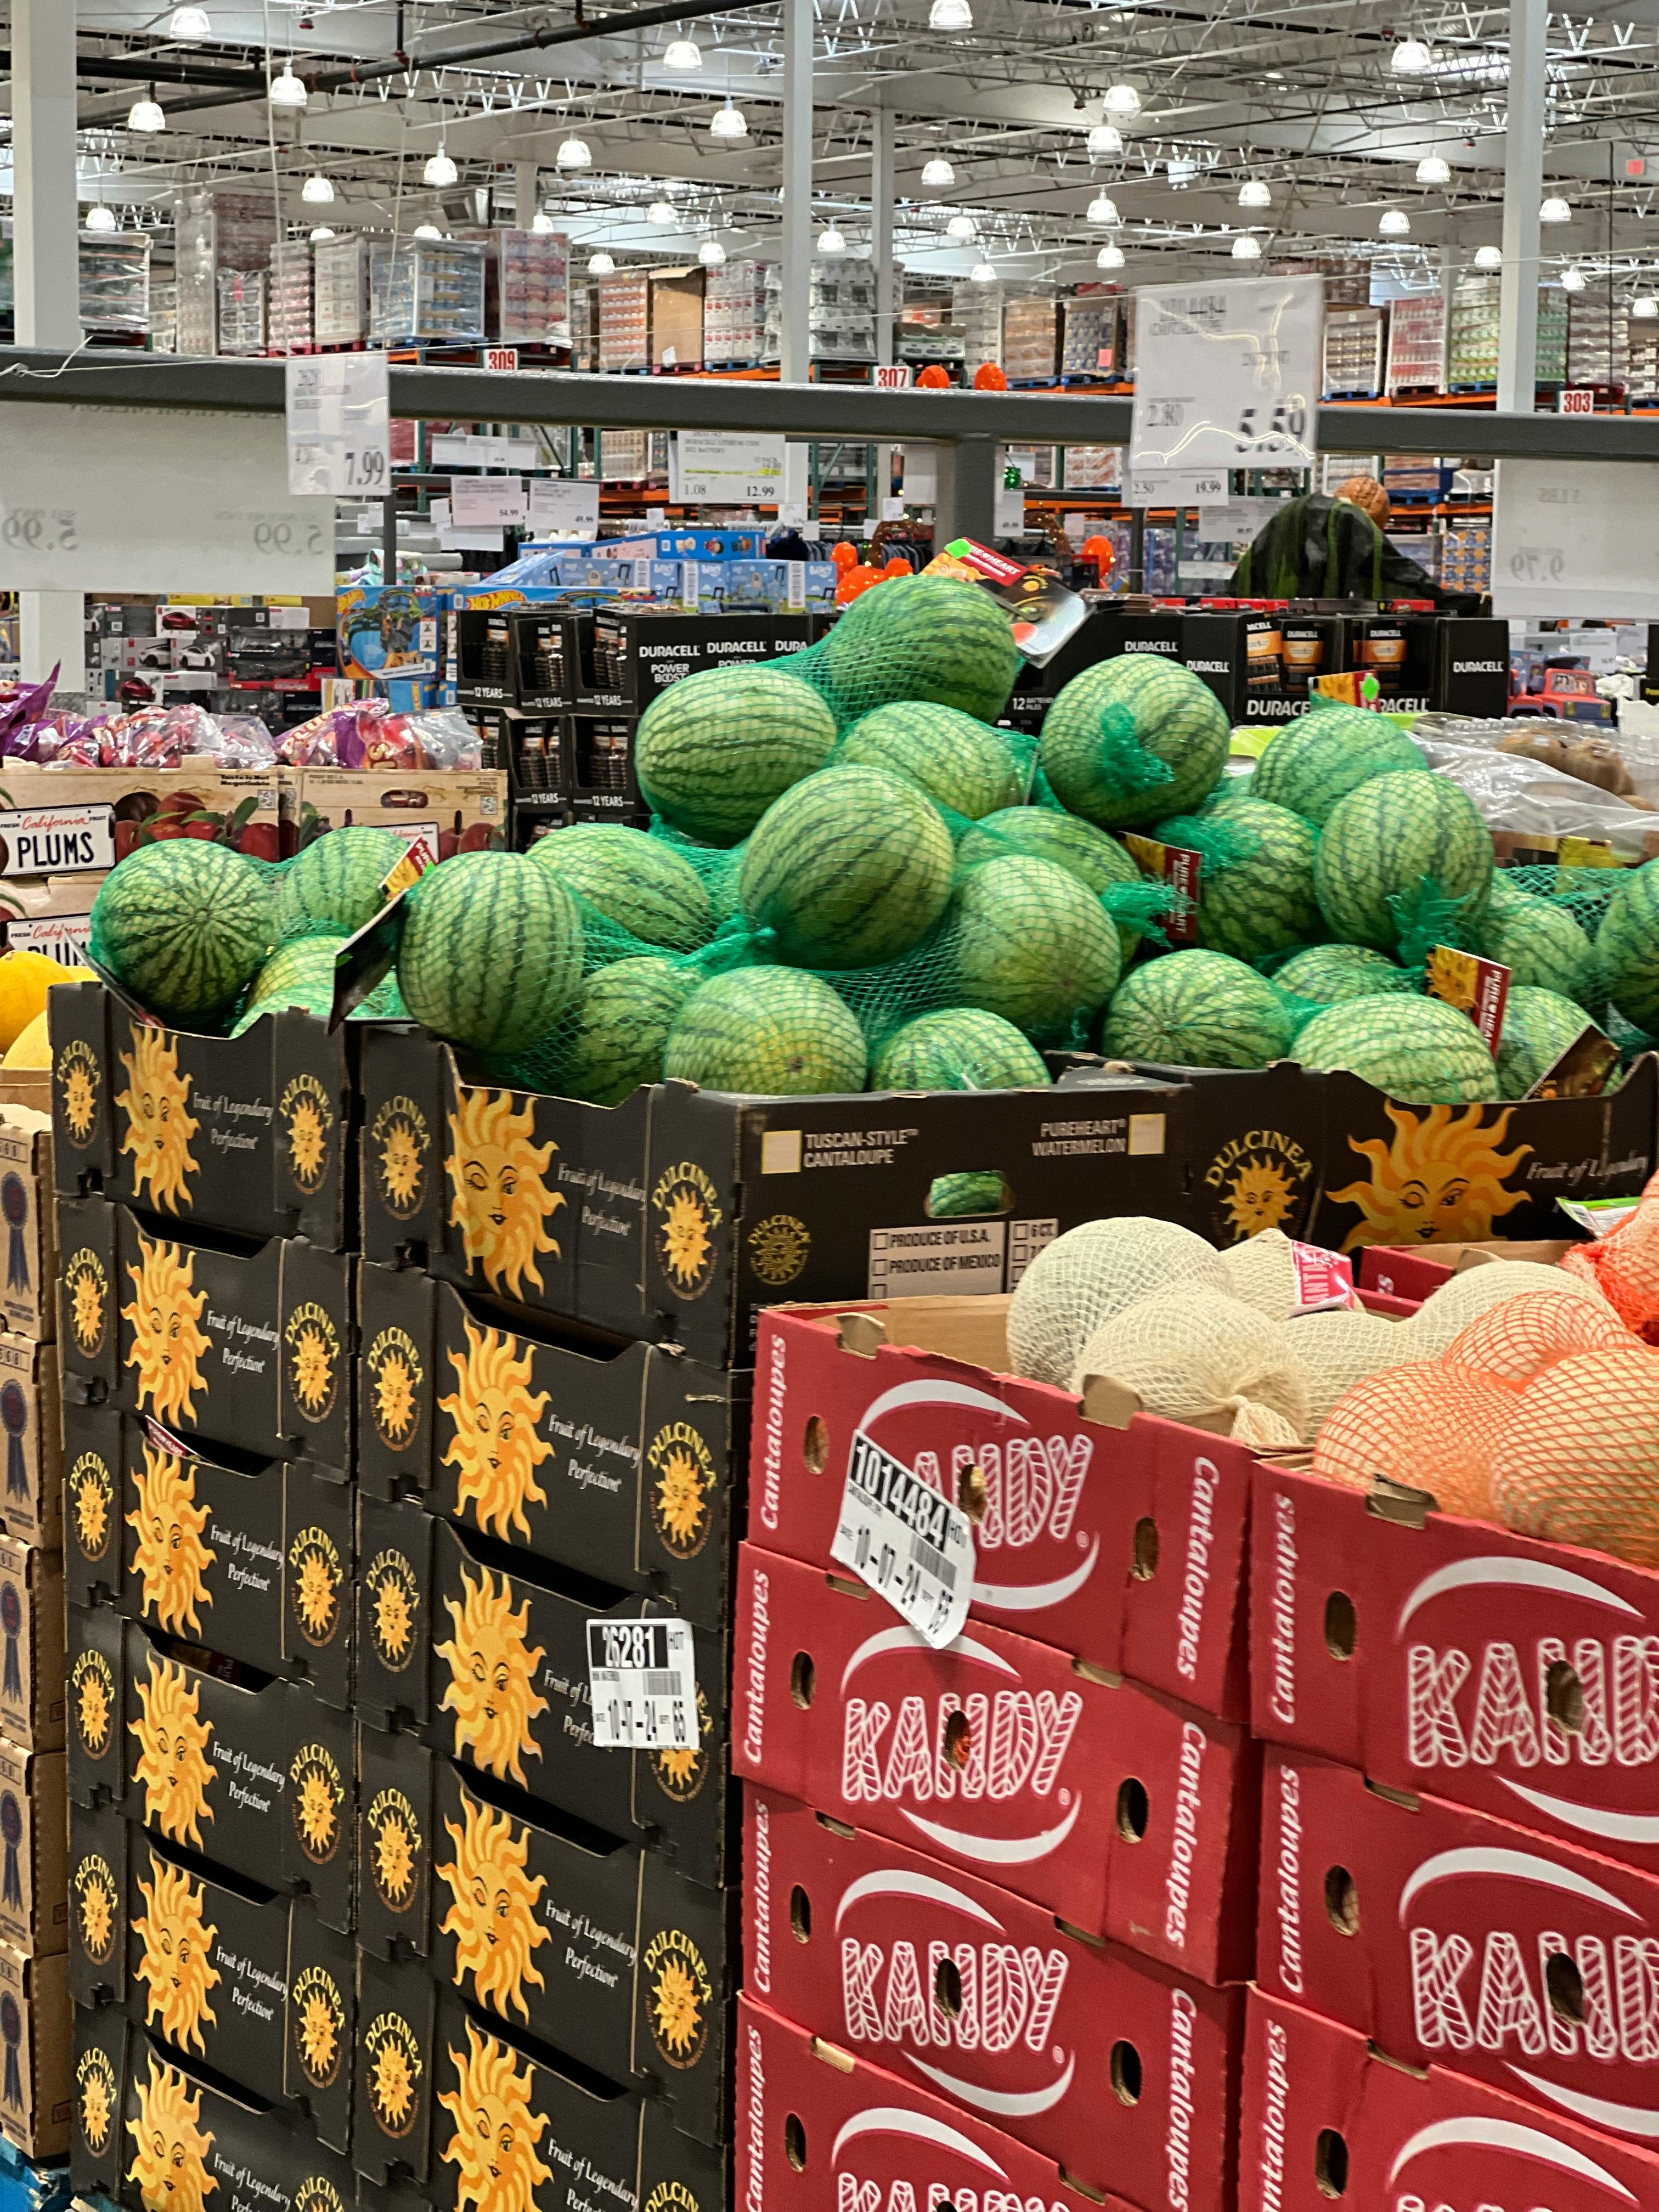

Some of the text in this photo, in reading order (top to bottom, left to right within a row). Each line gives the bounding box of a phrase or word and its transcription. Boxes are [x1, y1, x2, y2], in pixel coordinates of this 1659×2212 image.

[489, 351, 515, 370] 309
[878, 368, 906, 387] 307
[1564, 392, 1590, 413] 303
[345, 450, 384, 486] 7.99
[685, 484, 707, 495] 1.08
[746, 486, 775, 497] 12.99
[639, 645, 701, 658] DURACELL
[651, 664, 690, 674] POWER
[707, 641, 767, 653] DURACELL
[775, 640, 808, 652] DURA
[1125, 641, 1178, 652] DURACELL
[1187, 661, 1230, 673] DURACELL
[1453, 661, 1504, 673] DURACELL
[475, 687, 503, 698] 12 YEARS
[535, 697, 563, 708] 12 YEARS
[594, 695, 622, 706] 12 YEARS
[654, 674, 686, 683] BOOST
[1013, 697, 1025, 710] 12
[1246, 700, 1311, 716] DURACE
[22, 815, 89, 832] California
[531, 793, 558, 804] 12 YEARS
[591, 795, 623, 807] 12 YEARS
[17, 831, 94, 867] PLUMS
[371, 1094, 432, 1150] DULCINEA
[1031, 1138, 1127, 1156] WATERMELON
[803, 1149, 895, 1168] CANTALOUPE
[1205, 1129, 1314, 1188] DULCINEA
[651, 1160, 723, 1230] DULCINEA
[889, 1253, 1001, 1273] PRODUCE OF MEXICO
[890, 1228, 991, 1248] PRODUCE OF U.S.A.
[285, 1301, 341, 1359] DULCINEA
[367, 1325, 425, 1385] DULCINEA
[647, 1420, 718, 1491] DULCINEA
[760, 1333, 787, 1531] Cantaloupes
[70, 1451, 114, 1503] DULCINEA
[854, 1441, 946, 1546] 1014484
[211, 1524, 231, 1547] Fruit
[231, 1532, 241, 1555] of
[289, 1526, 343, 1587] DULCINEA
[365, 1548, 421, 1610] DULCINEA
[1175, 1455, 1220, 1681] Cantaloupes
[1270, 1493, 1301, 1725] Cantaloupes
[72, 1649, 116, 1702] DULCINEA
[742, 1568, 771, 1765] Cantaloupes
[1408, 1635, 1659, 1769] KAND
[213, 1741, 285, 1792] Fruit of Legendary
[842, 1689, 1084, 1802] KANDY
[290, 1743, 346, 1805] DULCINEA
[367, 1787, 422, 1852] DULCINEA
[1165, 1720, 1207, 1948] Cantaloupes
[74, 1854, 119, 1910] DULCINEA
[753, 1799, 774, 1994] Cantaloupes
[1277, 1763, 1304, 1995] Cantaloupes
[545, 1899, 638, 1968] Fruit of Legendary
[216, 1945, 289, 2001] Fruit of Legendary
[643, 1928, 713, 2004] DULCINEA
[292, 1966, 347, 2030] DULCINEA
[841, 1938, 1070, 2053] KANDY
[1410, 1927, 1659, 2062] KAND
[365, 2011, 424, 2079] DULCINEA
[76, 2046, 117, 2103] DULCINEA
[1165, 1987, 1198, 2212] Cantaloupes
[744, 2024, 765, 2212] Cantaloupes
[214, 2153, 291, 2210] Fruit of Legendary
[548, 2137, 639, 2205] Fruit of Legendary
